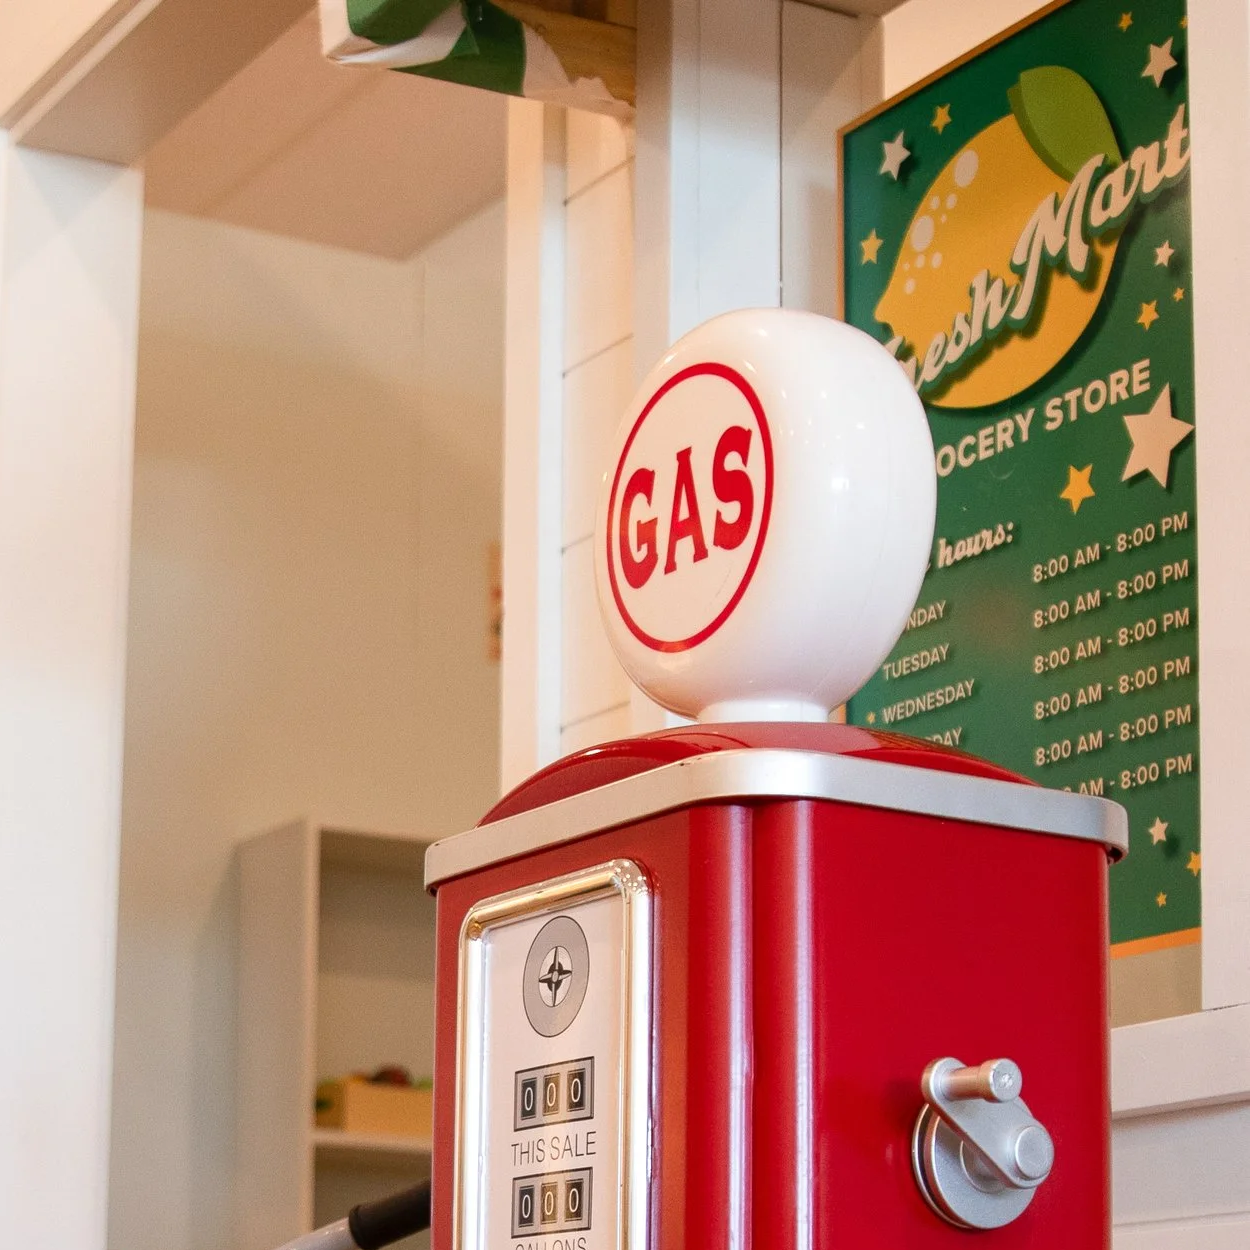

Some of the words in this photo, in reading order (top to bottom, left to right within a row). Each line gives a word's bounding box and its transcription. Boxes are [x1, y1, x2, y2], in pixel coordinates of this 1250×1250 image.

[1011, 103, 1191, 319] Mart
[936, 408, 1035, 477] OCERY
[1044, 358, 1151, 431] STORE
[619, 425, 754, 589] GAS
[937, 521, 1014, 569] hours:
[883, 643, 950, 680] TUESDAY
[1033, 601, 1069, 628] 8:00
[1075, 590, 1100, 614] AM
[1117, 571, 1156, 599] 8:00
[1162, 559, 1189, 584] PM
[906, 600, 946, 630] NDAY
[1033, 555, 1069, 583] 8:00
[1074, 543, 1100, 568] AM
[1117, 523, 1155, 552] 8:00
[1161, 511, 1188, 536] PM
[882, 679, 975, 724] WEDNESDAY
[1034, 647, 1070, 674] 8:00
[1076, 636, 1101, 660] AM
[1118, 619, 1156, 647] 8:00
[1163, 608, 1189, 632] PM
[1034, 693, 1071, 720] 8:00
[1076, 683, 1102, 707] AM
[1118, 666, 1157, 694] 8:00
[1164, 656, 1190, 680] PM
[1035, 740, 1071, 767] 8:00
[1077, 730, 1103, 754] AM
[1120, 714, 1158, 742] 8:00
[1165, 704, 1191, 729] PM
[1079, 778, 1103, 796] AM
[1121, 763, 1159, 789] 8:00
[1166, 753, 1192, 777] PM
[511, 1138, 545, 1166] THIS
[550, 1131, 596, 1161] SALE
